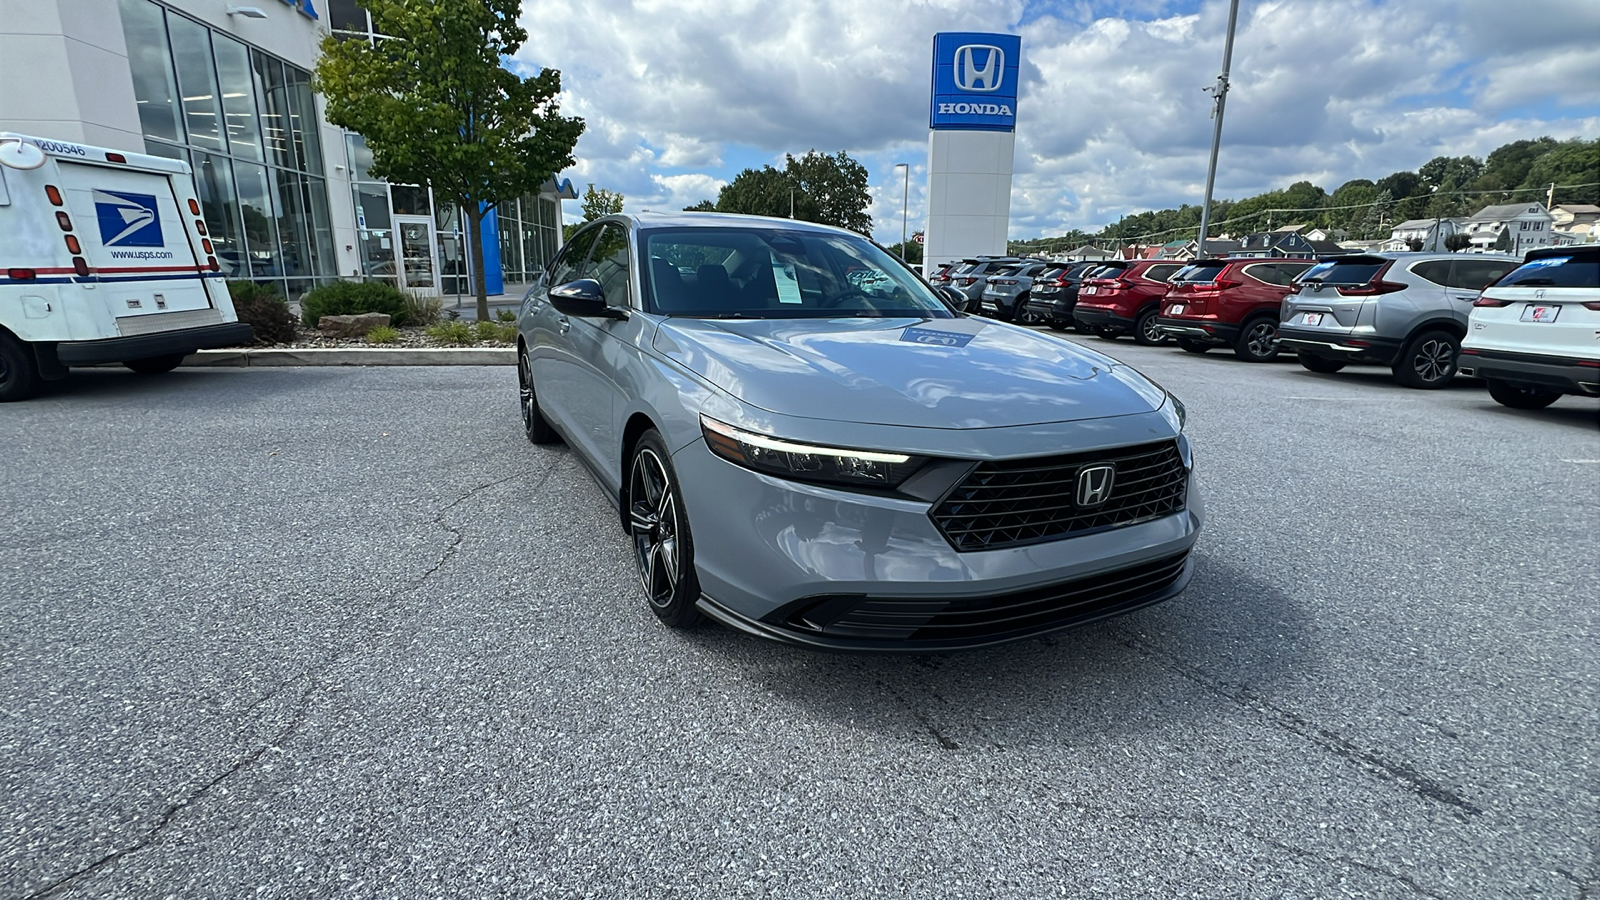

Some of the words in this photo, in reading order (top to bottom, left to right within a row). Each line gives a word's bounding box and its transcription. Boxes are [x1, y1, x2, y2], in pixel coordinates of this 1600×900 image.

[938, 103, 1013, 116] HONDA
[34, 139, 86, 156] 1200546
[110, 251, 173, 260] www.usps.com
